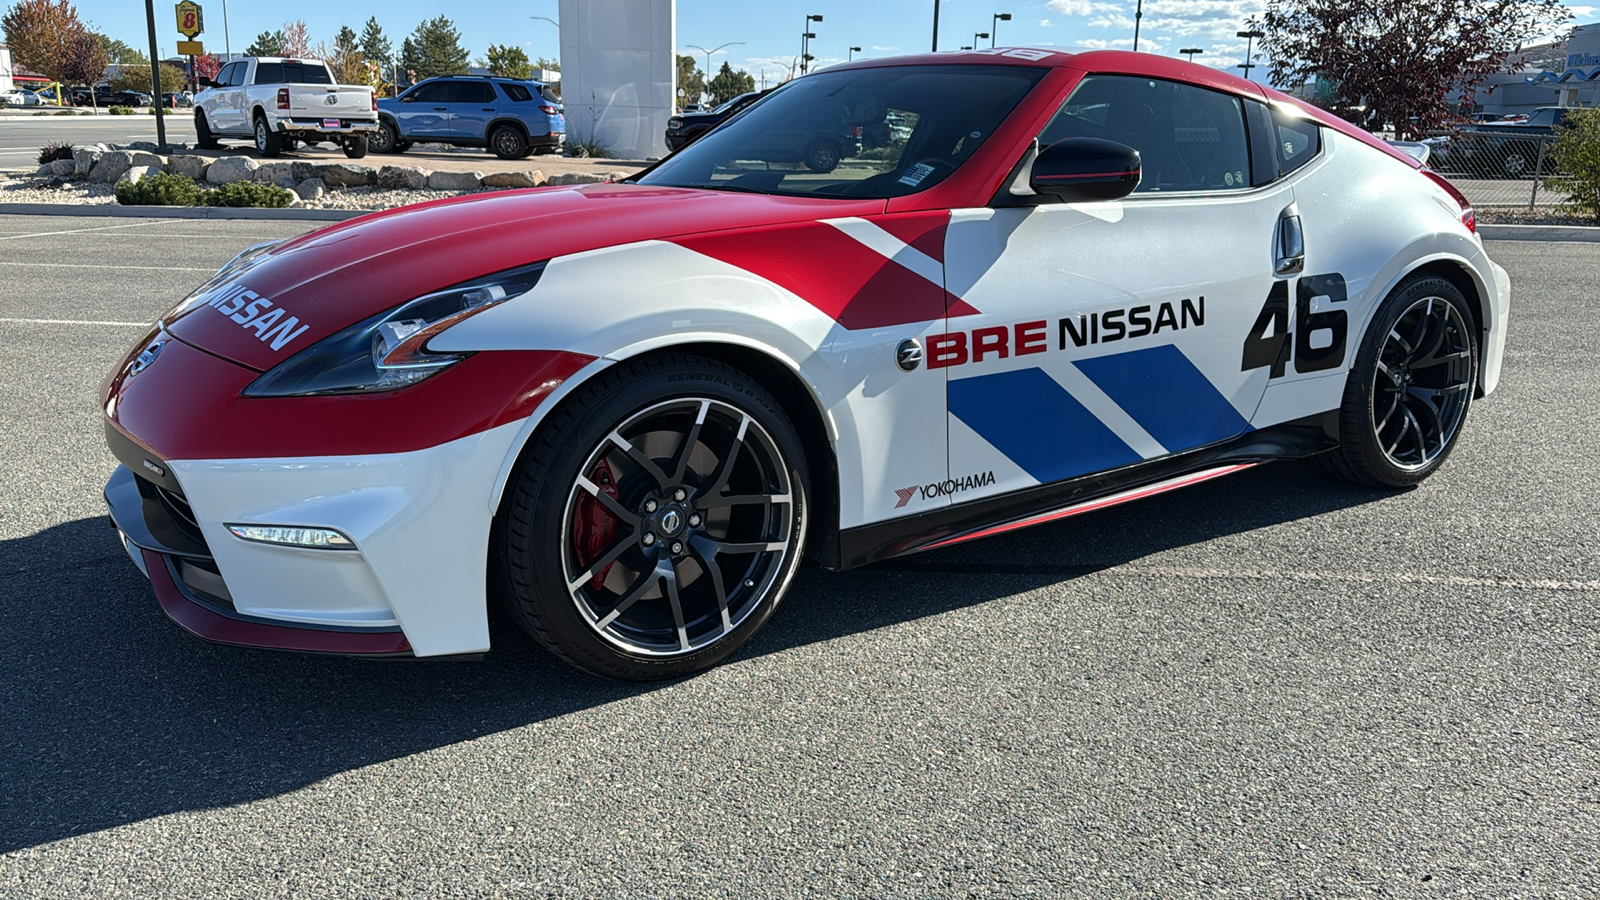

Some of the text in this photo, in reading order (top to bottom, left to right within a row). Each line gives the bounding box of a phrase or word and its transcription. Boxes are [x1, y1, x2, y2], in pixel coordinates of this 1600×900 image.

[183, 12, 196, 29] 8
[206, 282, 310, 351] NISSAN
[925, 296, 1205, 370] BRE NISSAN
[1241, 272, 1348, 380] 46
[667, 373, 731, 387] GENERAL
[919, 470, 996, 501] YOKOHAMA
